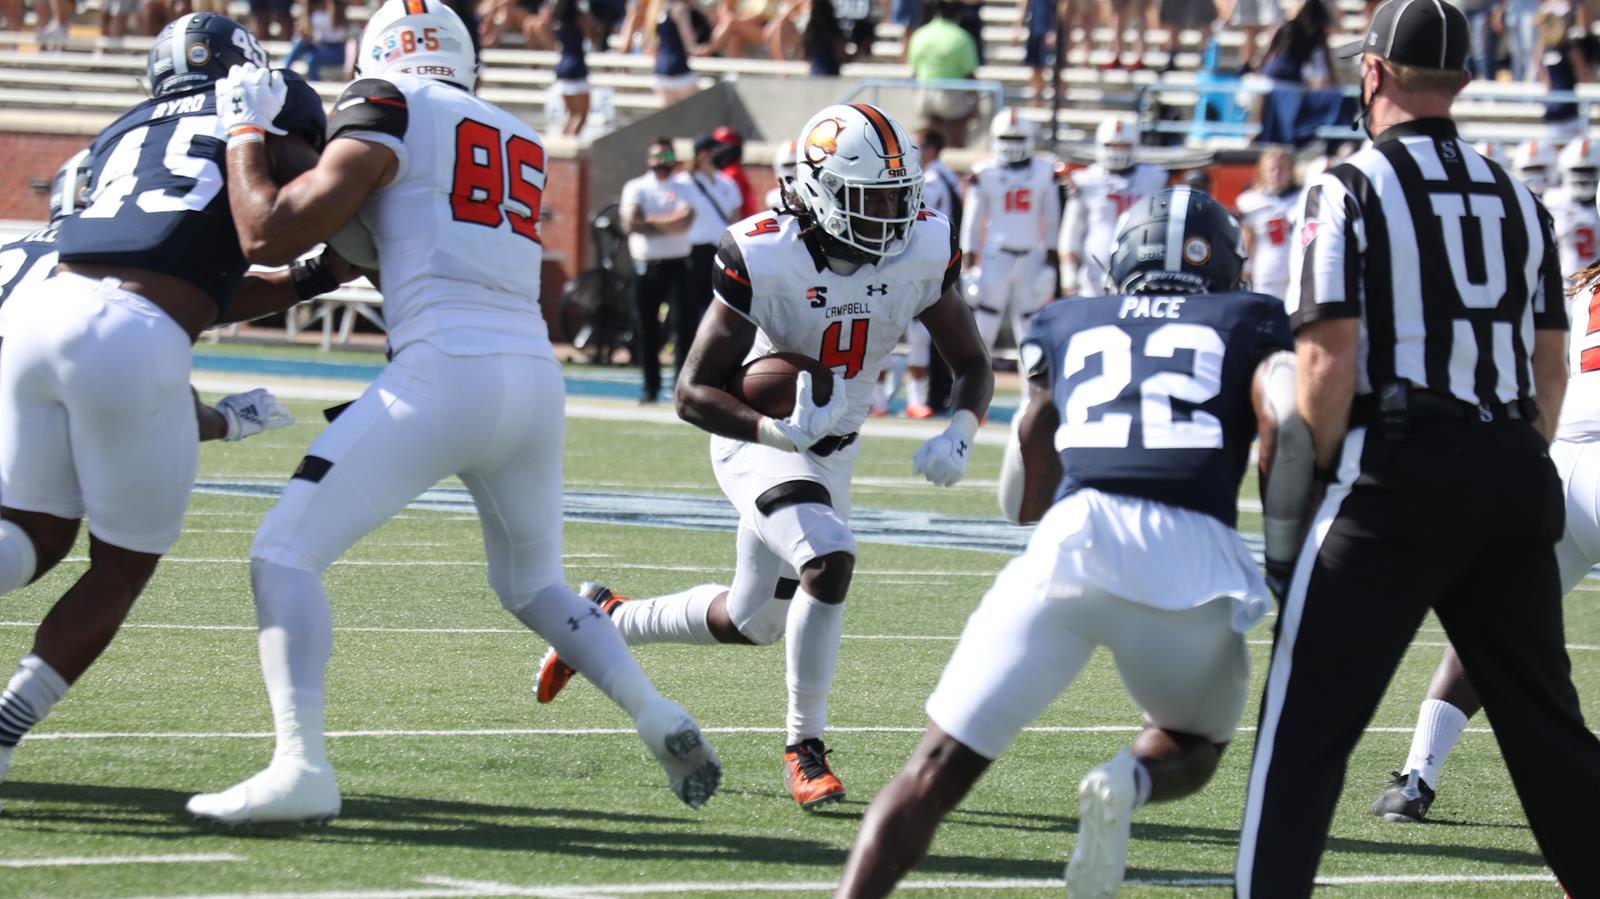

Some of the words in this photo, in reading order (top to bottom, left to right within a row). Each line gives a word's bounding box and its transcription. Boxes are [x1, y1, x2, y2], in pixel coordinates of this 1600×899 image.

[417, 65, 455, 77] CREEK
[148, 94, 206, 120] BYRD
[80, 115, 224, 218] 45
[450, 117, 543, 245] 85
[1428, 192, 1506, 309] U
[825, 302, 871, 318] CAMPBELL
[1118, 296, 1186, 319] PACE
[819, 318, 869, 380] 4
[1054, 323, 1226, 450] 22
